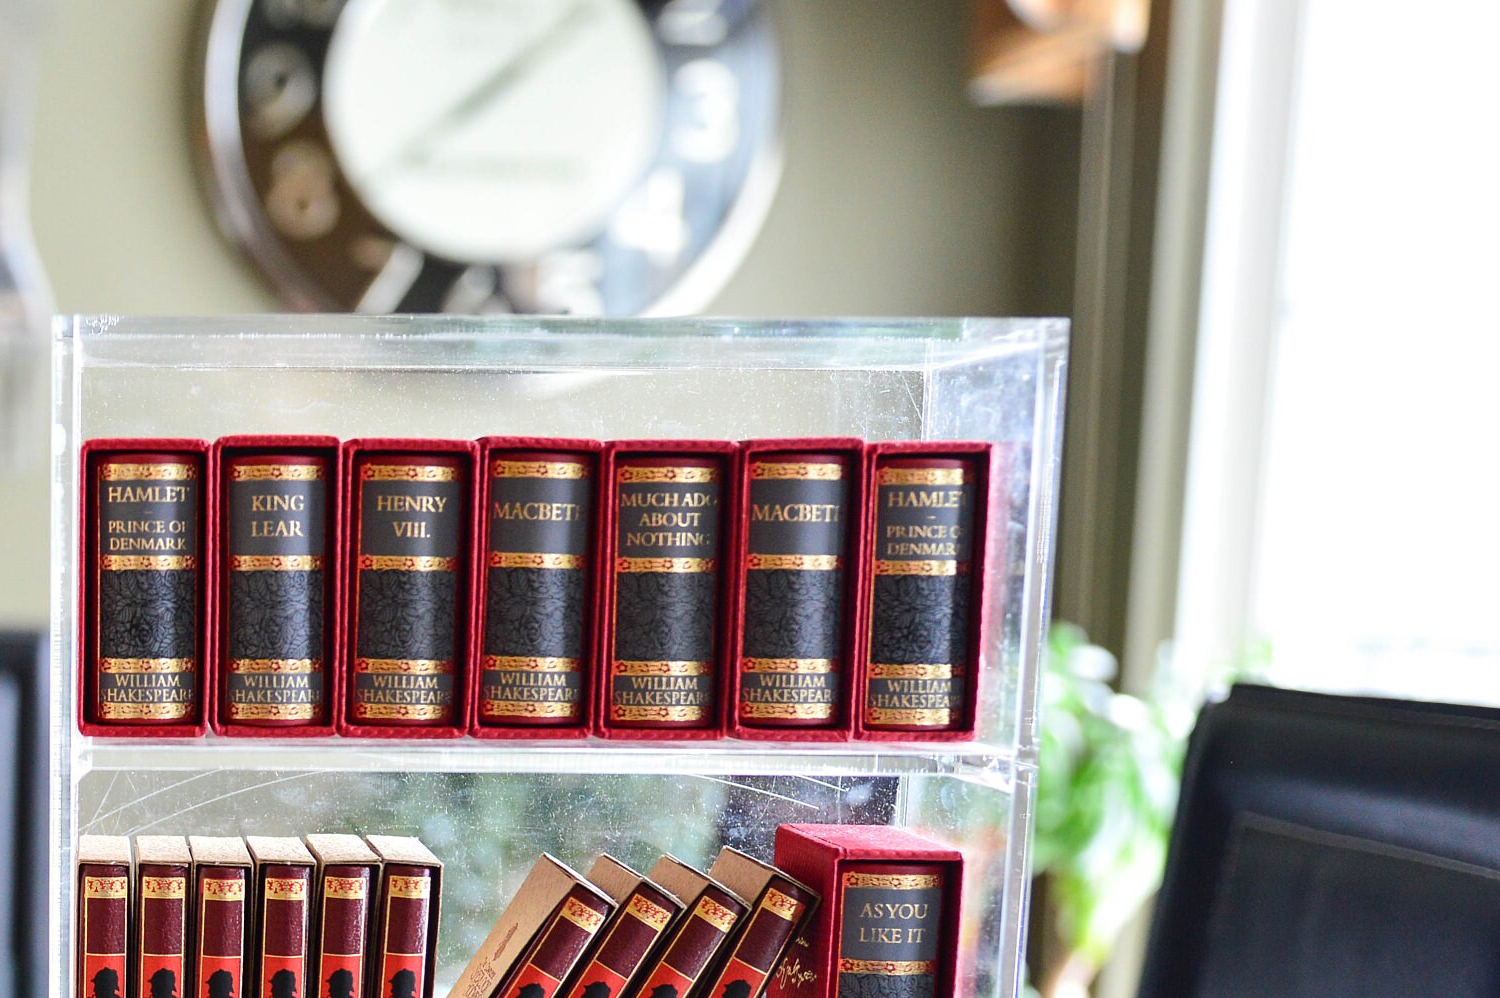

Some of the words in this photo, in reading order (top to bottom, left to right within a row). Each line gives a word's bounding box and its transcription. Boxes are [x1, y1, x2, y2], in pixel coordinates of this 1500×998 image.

[108, 486, 189, 502] HAMLET
[621, 493, 680, 507] MUCH
[251, 495, 304, 512] KING
[377, 496, 447, 513] HENRY
[639, 512, 701, 527] ABOUT
[108, 521, 165, 534] PRINCE
[251, 521, 304, 537] LEAR
[393, 521, 430, 538] VIII.
[110, 538, 186, 550] DENMARK
[116, 674, 180, 688] WILLIAM
[244, 675, 308, 688] WILLIAM
[373, 675, 437, 689] WILLIAM
[501, 674, 566, 686] WILLIAM
[632, 677, 698, 690] WILLIAM
[861, 903, 883, 918] AS
[887, 904, 929, 918] YOU
[860, 929, 901, 944] LIKE
[908, 928, 925, 942] IT
